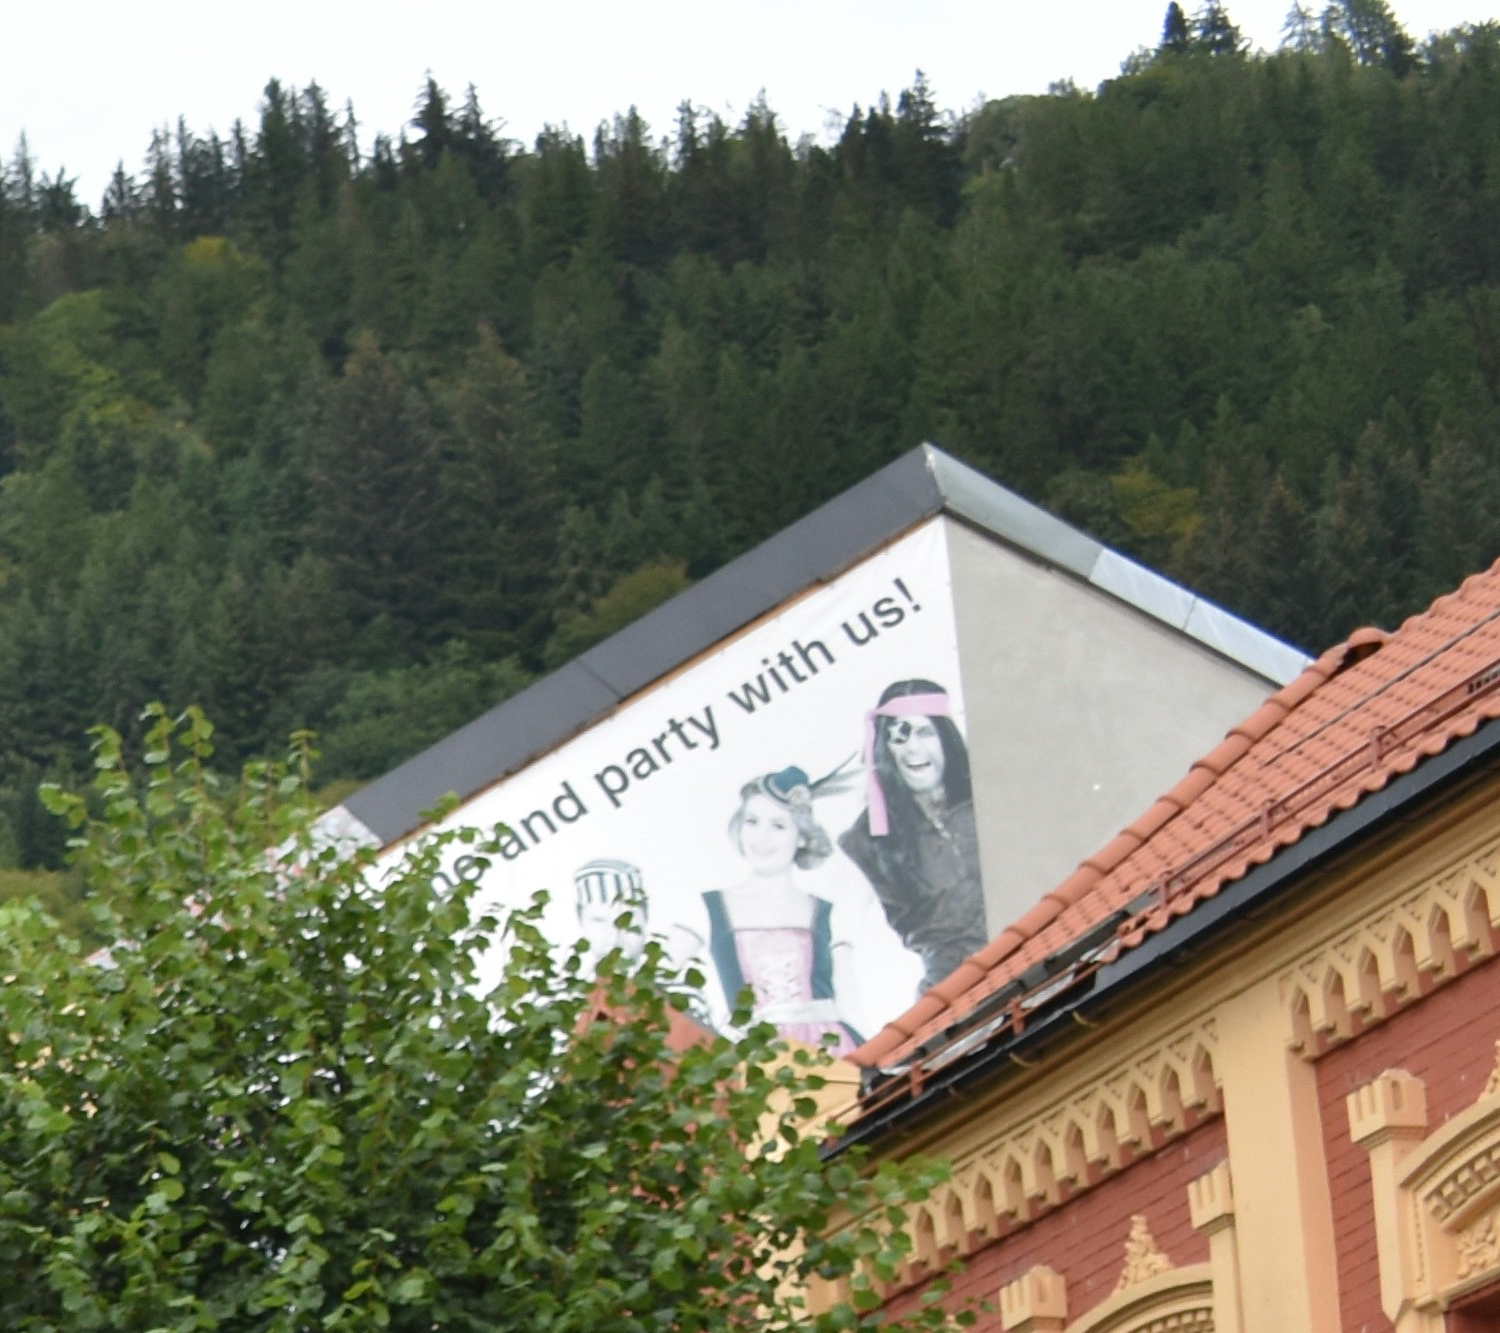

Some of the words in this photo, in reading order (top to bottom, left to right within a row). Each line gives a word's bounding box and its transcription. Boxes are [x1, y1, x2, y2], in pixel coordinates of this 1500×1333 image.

[499, 780, 588, 861] and
[594, 705, 720, 808] party
[727, 636, 835, 713] with
[841, 577, 922, 646] us!
